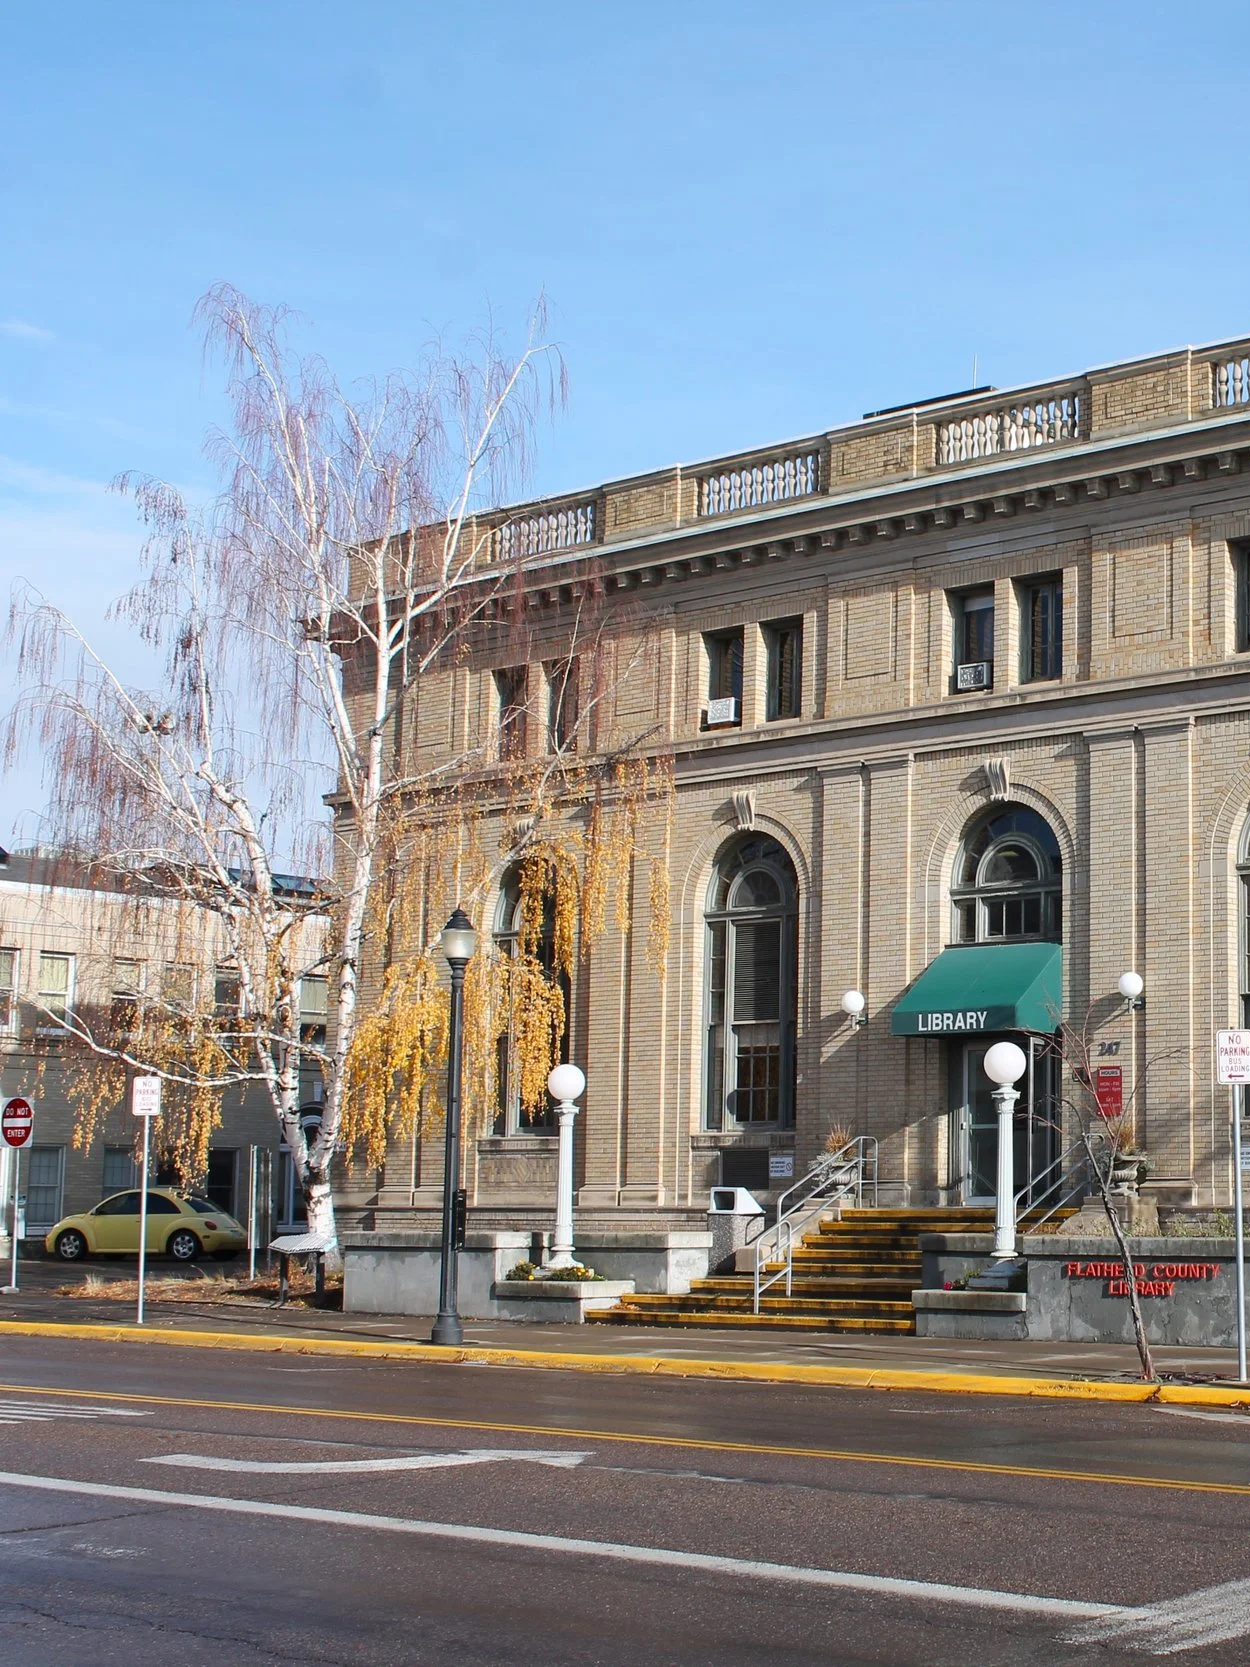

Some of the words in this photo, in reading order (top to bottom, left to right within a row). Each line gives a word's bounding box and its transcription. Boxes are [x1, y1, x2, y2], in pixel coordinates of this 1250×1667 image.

[918, 1011, 988, 1031] LIBRARY
[1228, 1035, 1241, 1044] NO
[1220, 1047, 1250, 1056] PARKING
[6, 1108, 14, 1116] DO
[17, 1107, 29, 1115] NOT
[1067, 1262, 1146, 1278] FLATHED
[1152, 1263, 1221, 1278] COUNTY
